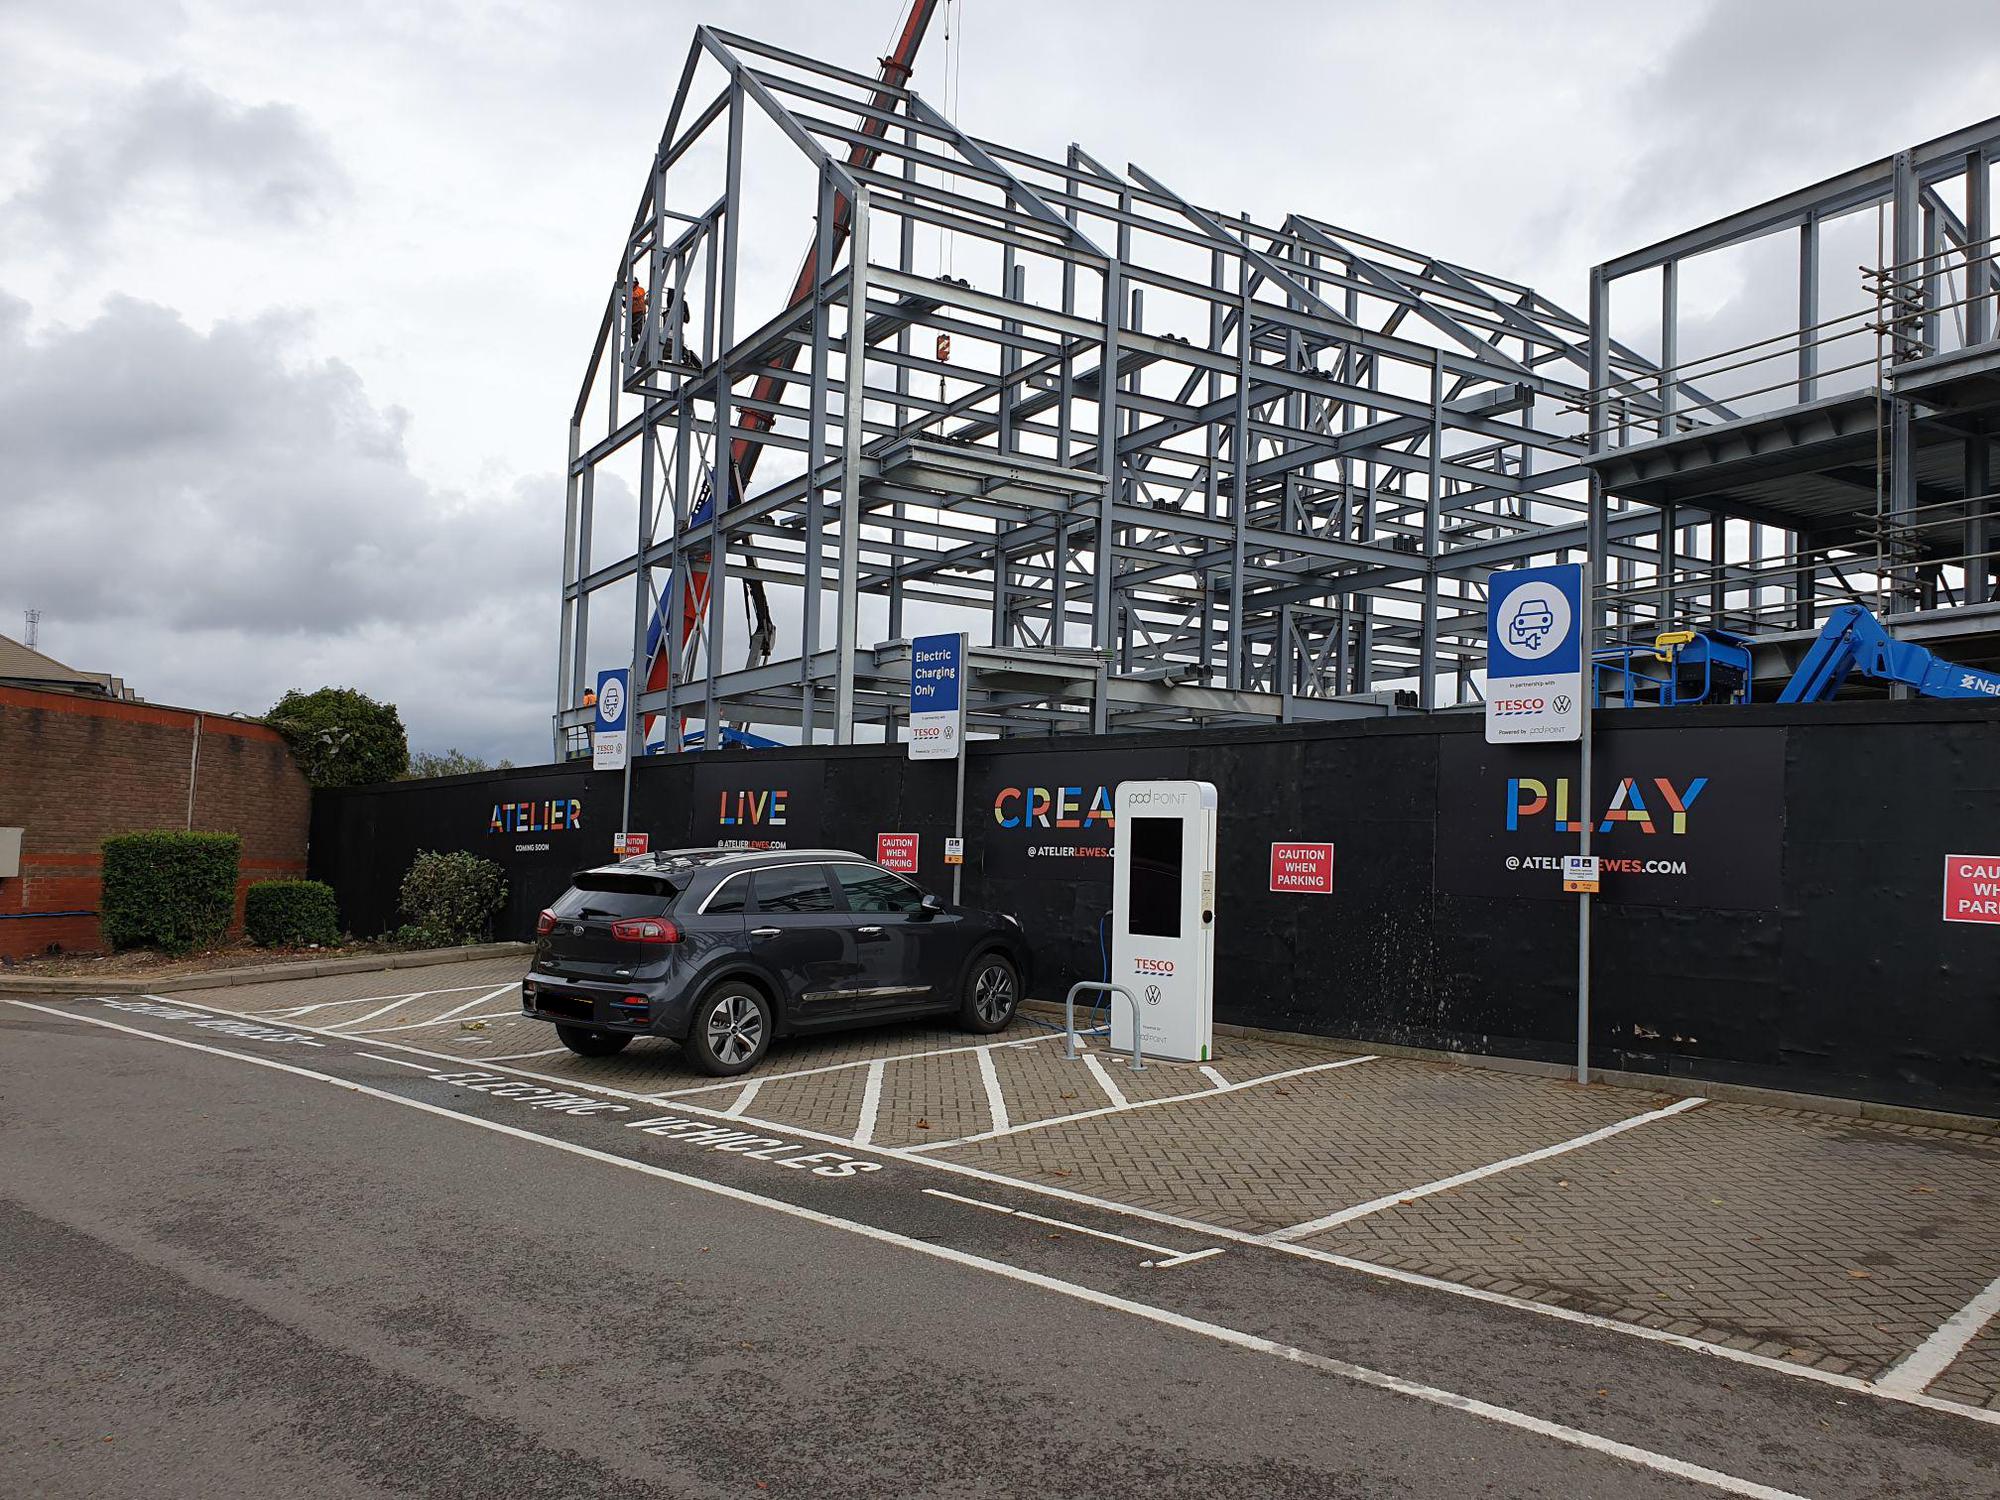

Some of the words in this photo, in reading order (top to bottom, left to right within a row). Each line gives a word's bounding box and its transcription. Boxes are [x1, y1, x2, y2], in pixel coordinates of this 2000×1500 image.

[916, 649, 951, 662] Electric
[915, 666, 955, 680] Charging
[914, 685, 935, 697] Only
[1494, 698, 1545, 711] TESCO
[914, 728, 940, 736] TESCO
[1153, 792, 1188, 805] POINT
[719, 790, 788, 825] LIVE
[994, 786, 1115, 828] CREA
[1506, 777, 1709, 834] PLAY
[489, 799, 581, 833] ATELIER
[882, 838, 913, 847] CAUTION
[886, 848, 907, 857] WHEN
[1278, 849, 1325, 860] CAUTION
[881, 859, 912, 868] PARKING
[1285, 862, 1317, 873] WHEN
[1277, 875, 1325, 886] PARKING
[1958, 899, 2000, 915] PAR
[1134, 958, 1174, 972] TESCO
[428, 1072, 631, 1116] ELECTRIC
[625, 1116, 884, 1178] VEHICLES
